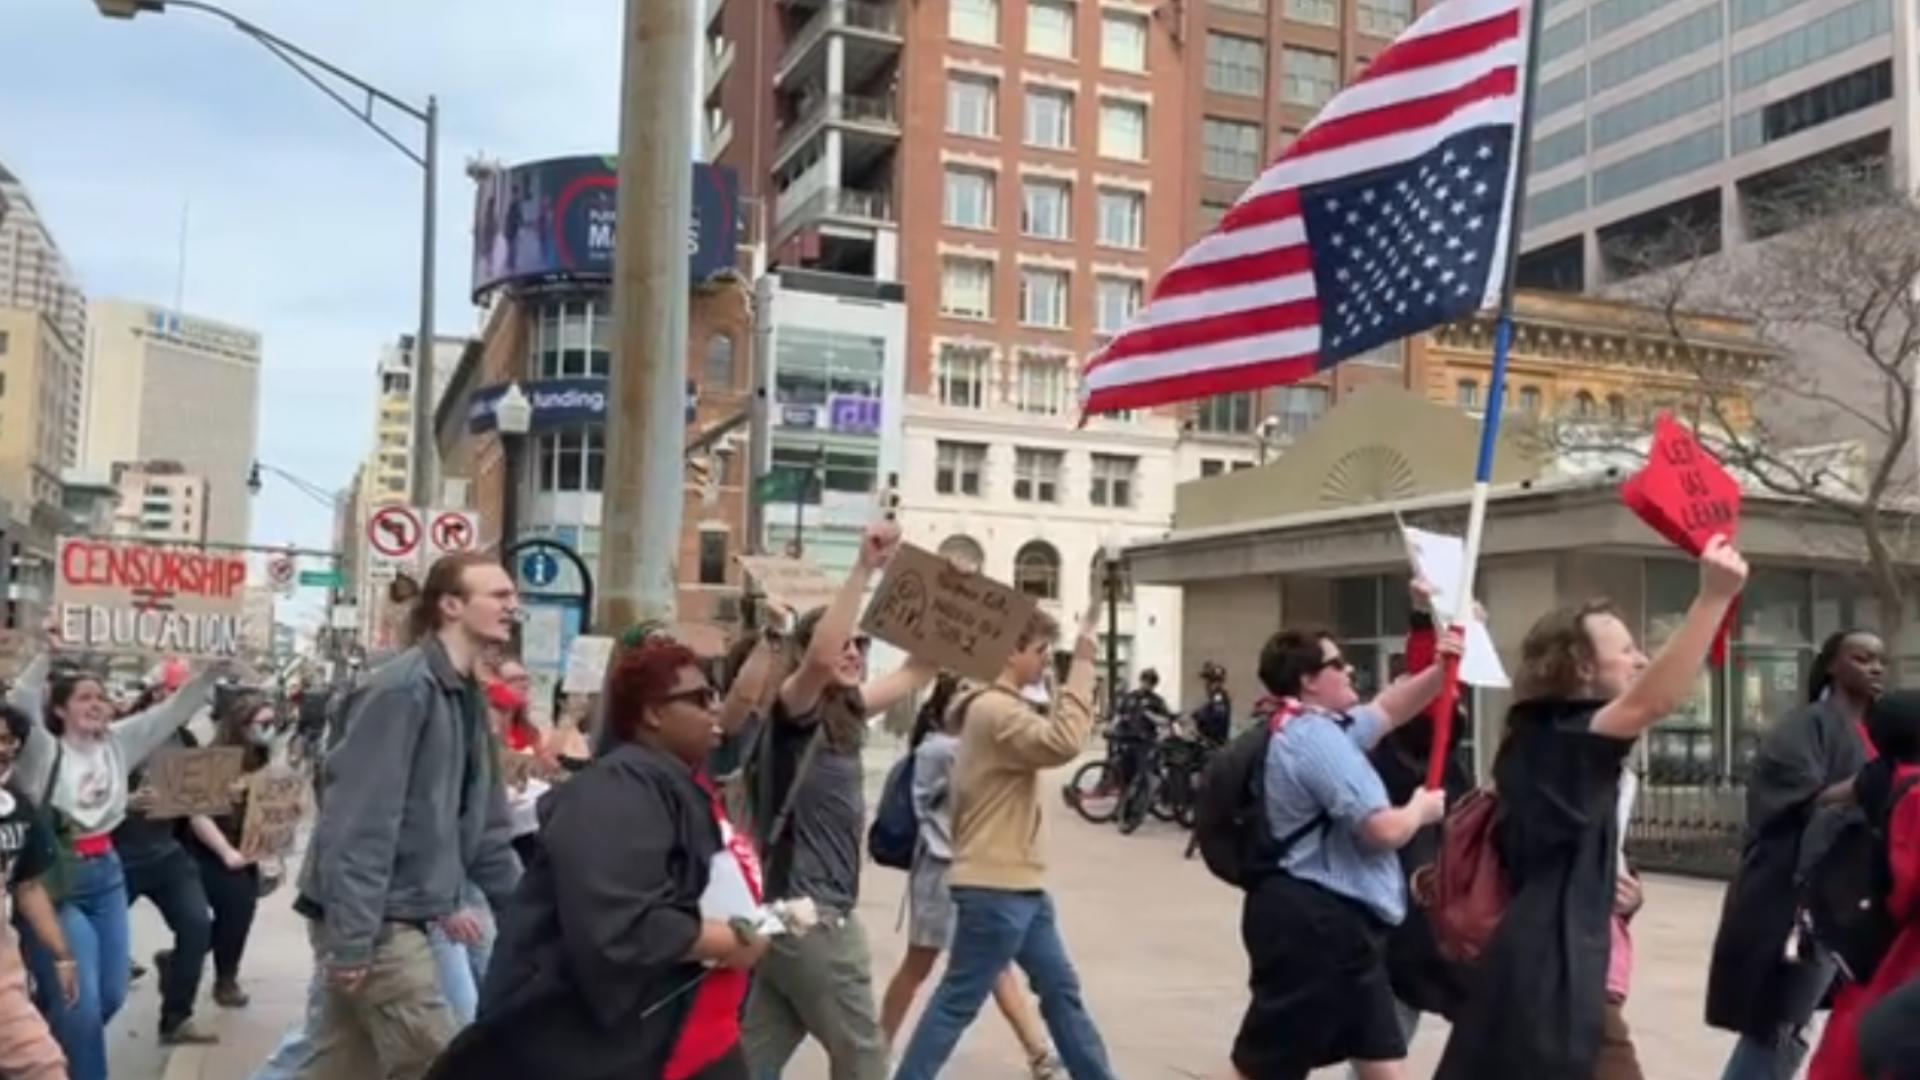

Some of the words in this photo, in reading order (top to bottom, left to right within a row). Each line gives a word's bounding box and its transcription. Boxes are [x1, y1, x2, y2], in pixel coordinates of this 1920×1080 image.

[1663, 437, 1696, 465] LET
[63, 540, 246, 598] CENSORSHIP
[62, 602, 240, 656] EDUCATION
